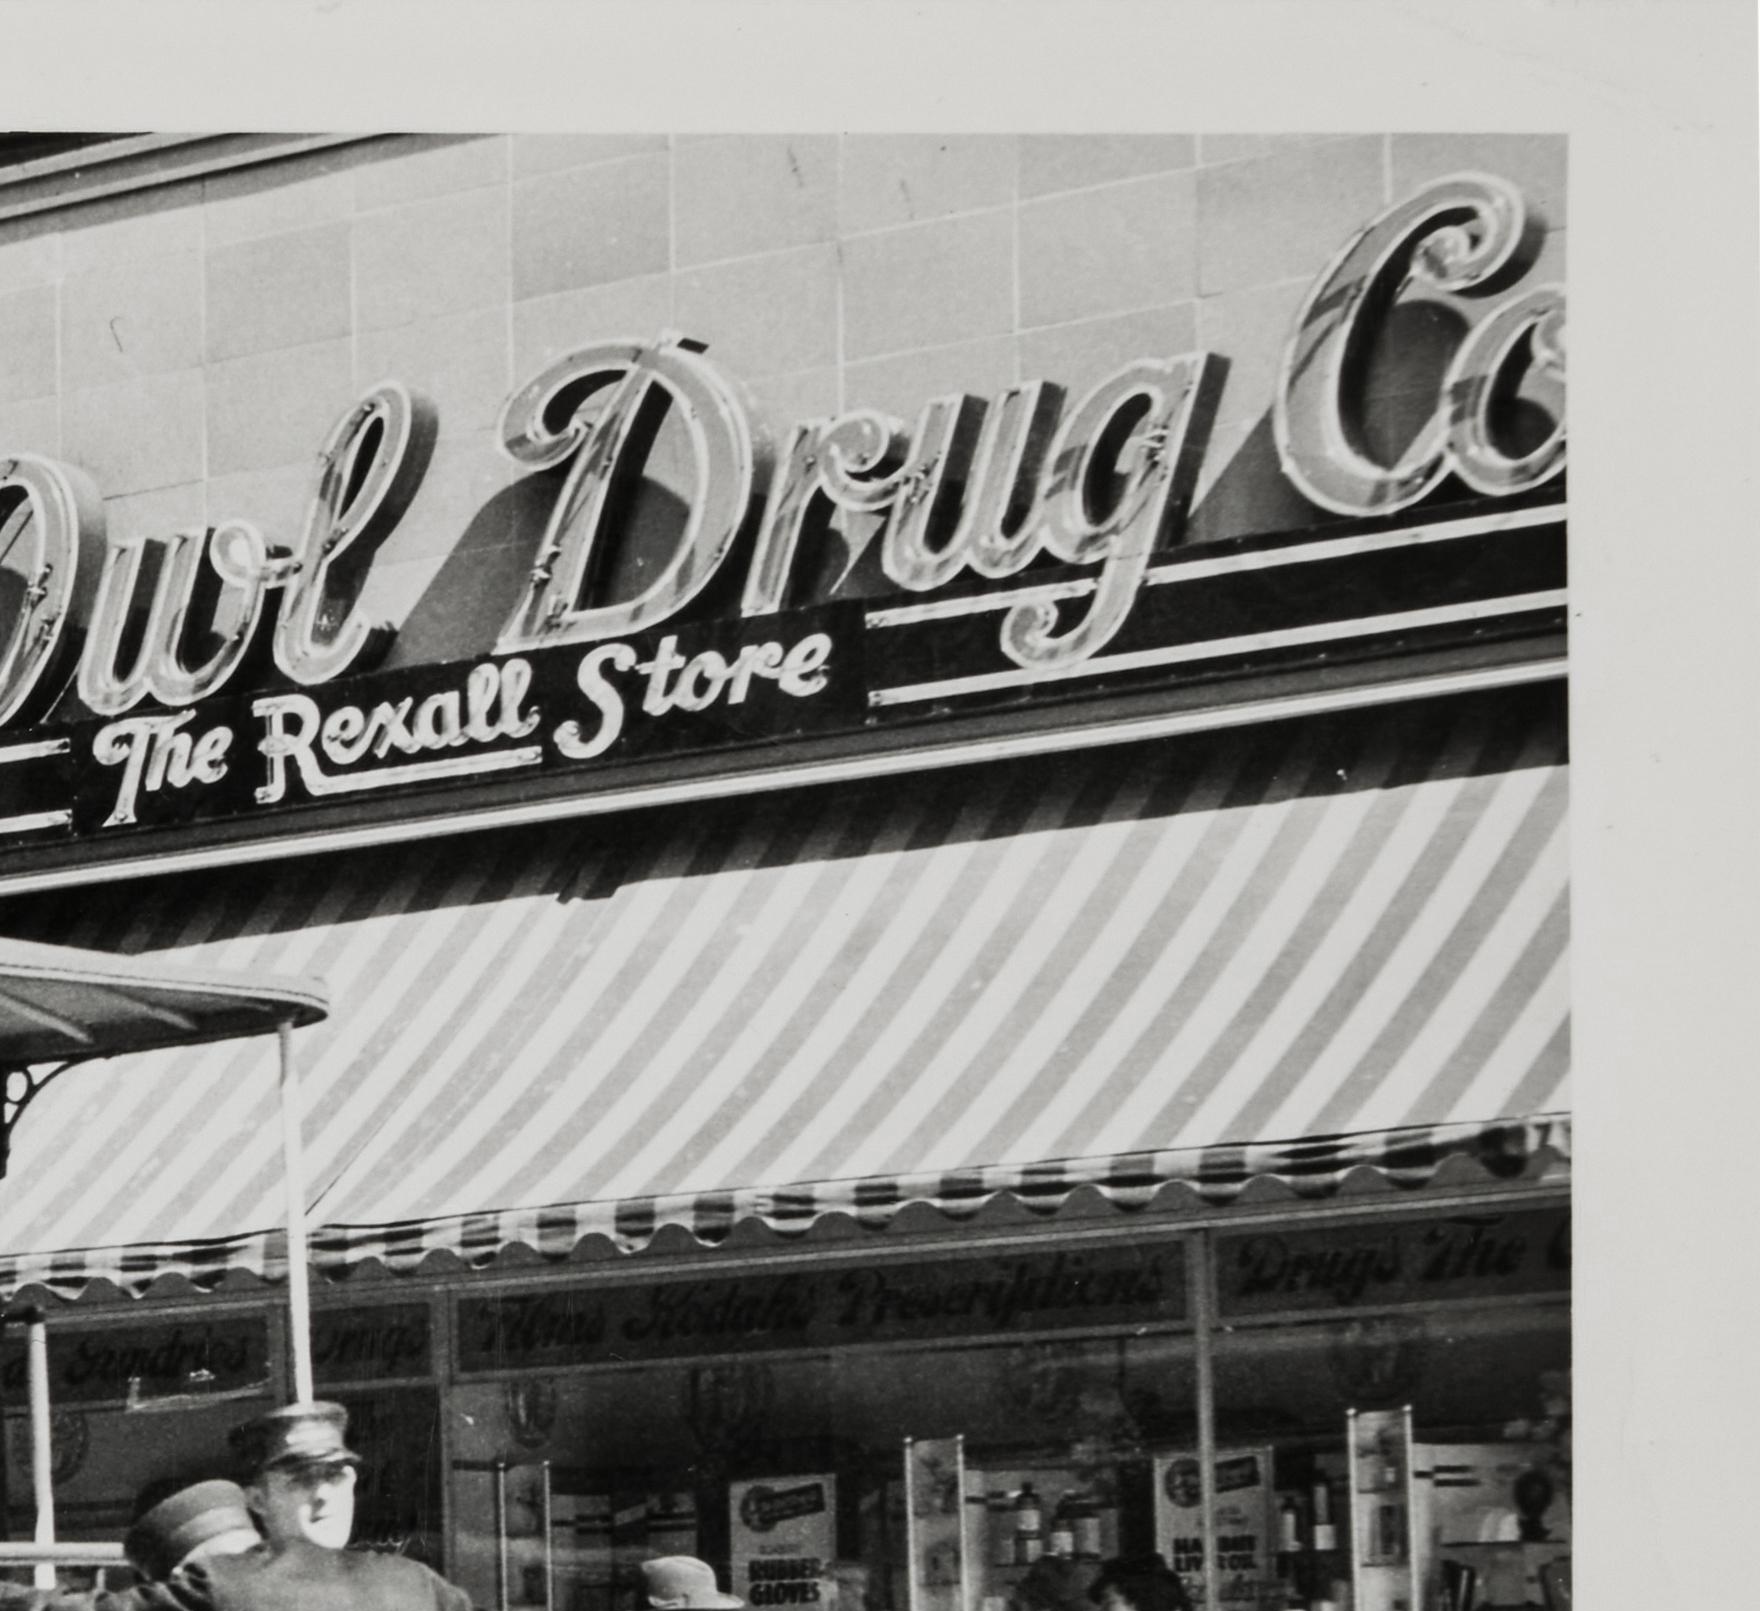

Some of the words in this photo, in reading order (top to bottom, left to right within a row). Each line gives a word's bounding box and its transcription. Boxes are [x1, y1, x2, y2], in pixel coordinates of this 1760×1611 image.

[496, 332, 1230, 670] Drug
[92, 706, 231, 827] The
[252, 658, 543, 803] Rexall
[554, 630, 832, 760] Store
[749, 1581, 821, 1606] GLOVES
